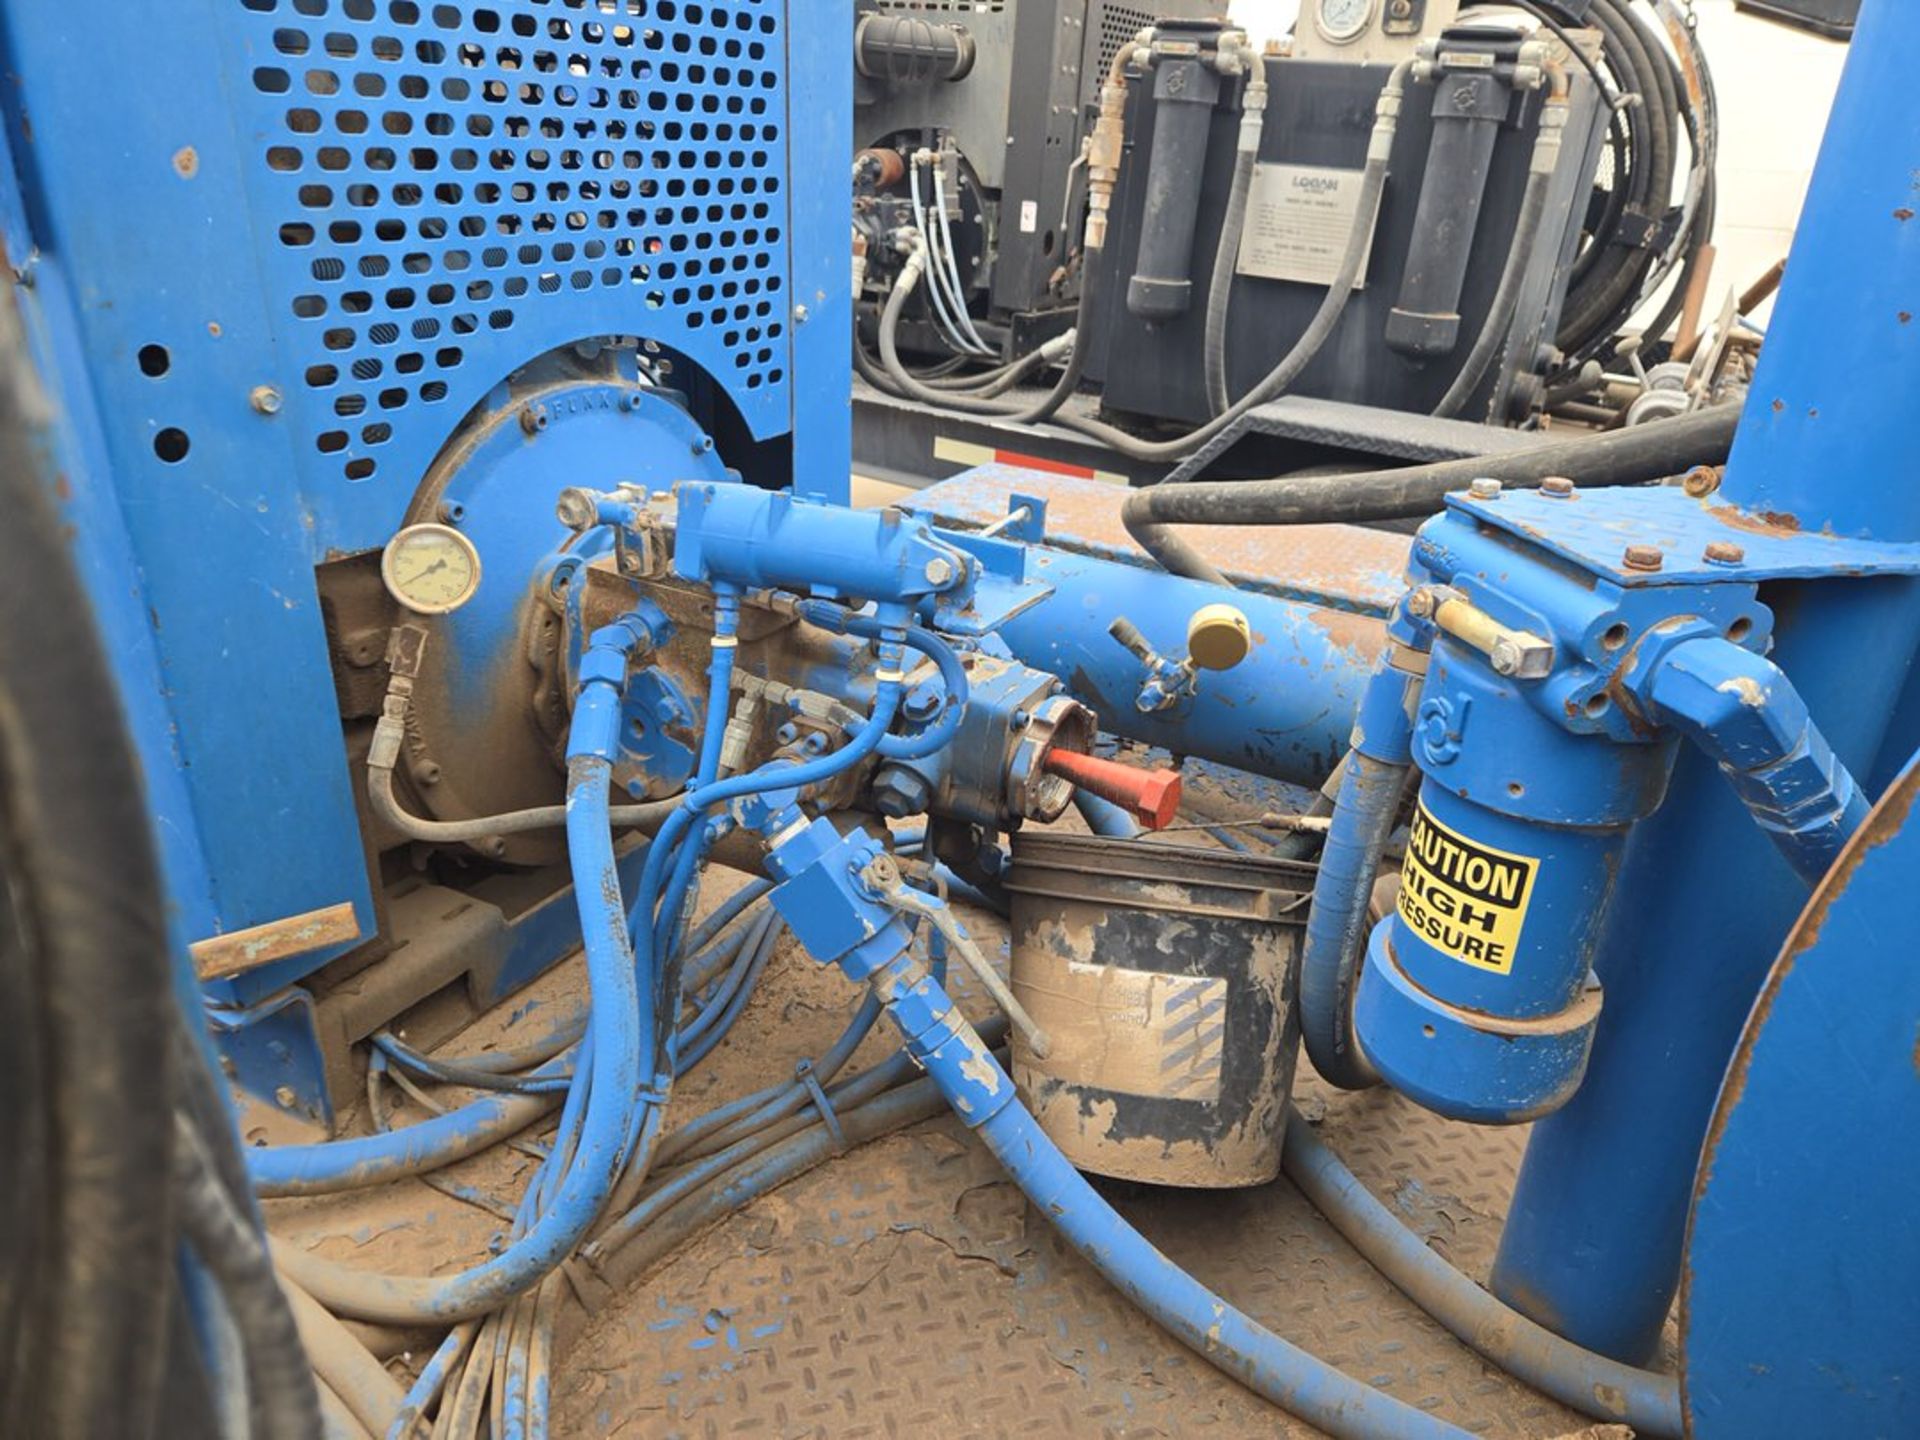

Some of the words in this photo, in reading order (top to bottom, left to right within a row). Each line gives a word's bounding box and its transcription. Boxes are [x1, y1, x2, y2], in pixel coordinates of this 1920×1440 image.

[1292, 176, 1338, 191] LOGAN
[1400, 887, 1505, 966] RESSURE
[1404, 855, 1498, 934] HIGH
